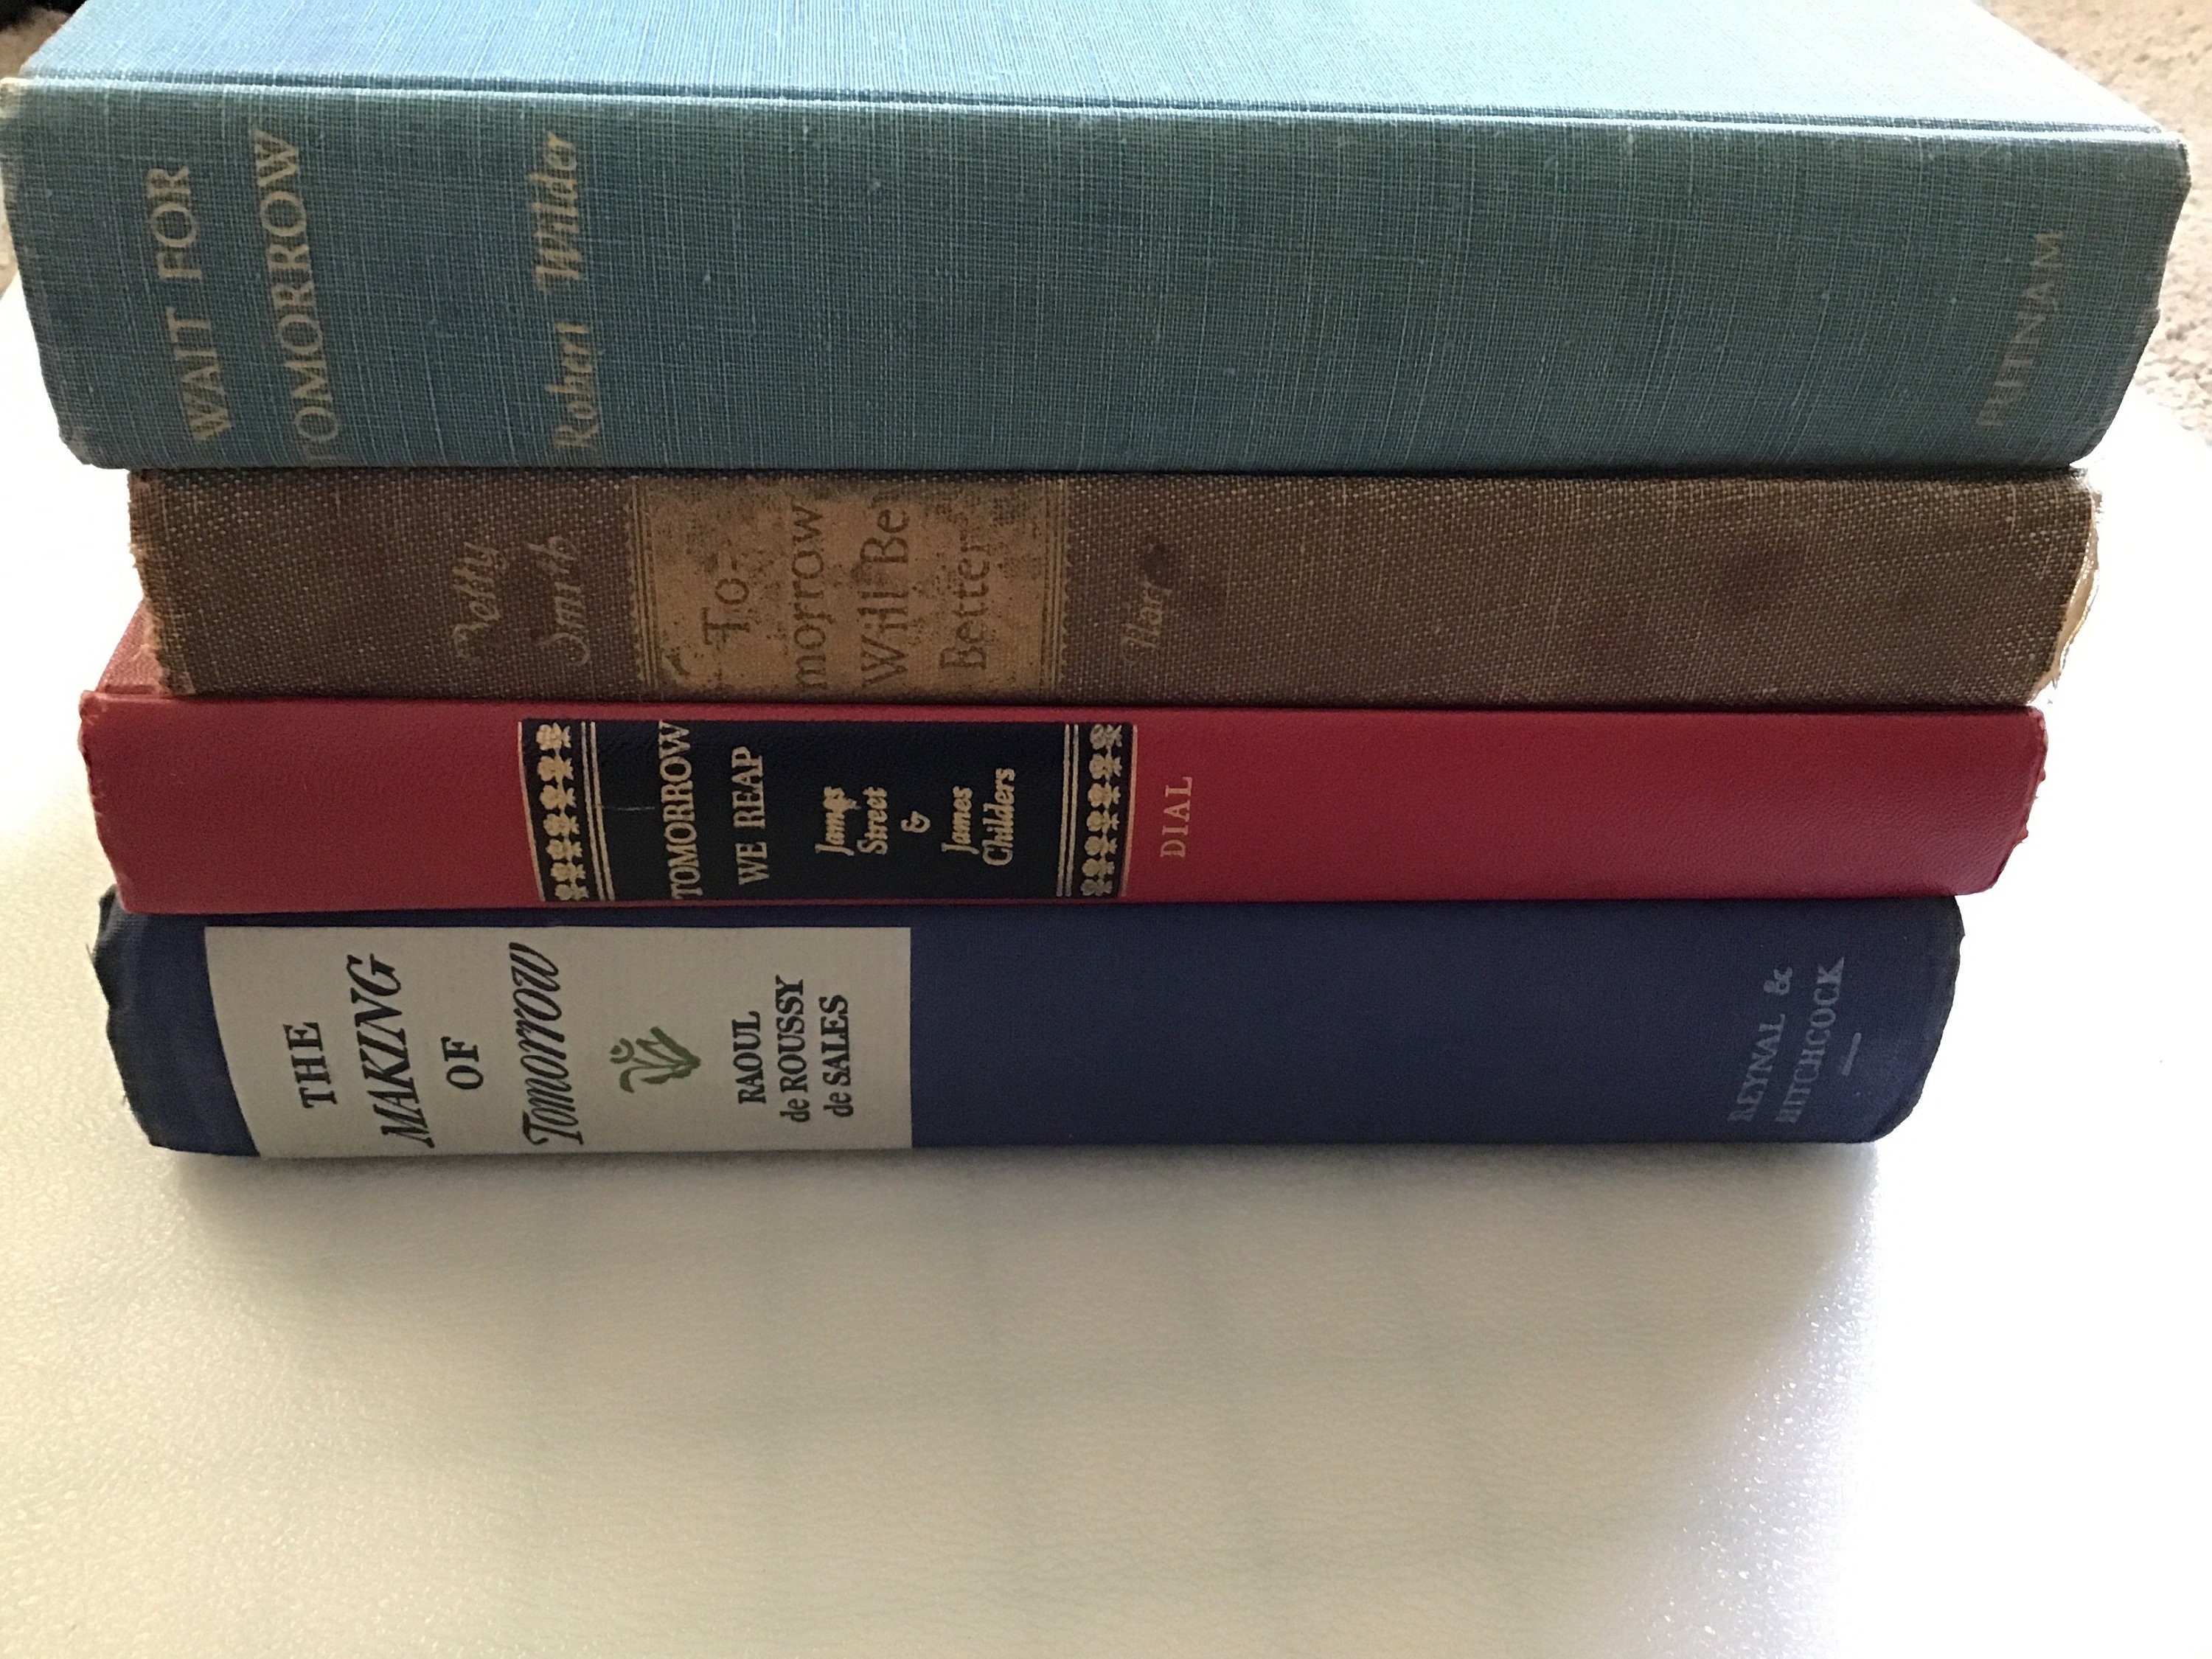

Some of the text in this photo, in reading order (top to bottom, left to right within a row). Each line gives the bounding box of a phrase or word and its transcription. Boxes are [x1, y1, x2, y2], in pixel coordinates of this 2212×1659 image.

[148, 165, 232, 442] WAIT FOR
[251, 128, 347, 465] TOMORROW
[527, 131, 599, 451] Robert Wilder
[1977, 229, 2064, 426] PUTNAM
[791, 503, 828, 692] morrow
[858, 507, 910, 688] Will Be
[939, 538, 990, 670] Better
[658, 720, 703, 900] TOMORROW
[731, 746, 770, 885] WE REAP
[815, 786, 856, 856] James
[857, 786, 888, 855] Street
[901, 811, 931, 833] &
[942, 785, 980, 854] James
[983, 768, 1016, 866] Childers
[1160, 776, 1193, 858] DIAL
[283, 1021, 338, 1108] THE
[347, 953, 435, 1149] MAKING
[441, 1036, 484, 1090] OF
[509, 942, 584, 1145] Tomorrow
[731, 1011, 766, 1105] RAOUL
[775, 974, 810, 1123] de ROUSSY
[818, 995, 854, 1118] de SALES
[1727, 966, 1793, 1123] REYNAL &
[1774, 957, 1844, 1124] HITCHCOCK
